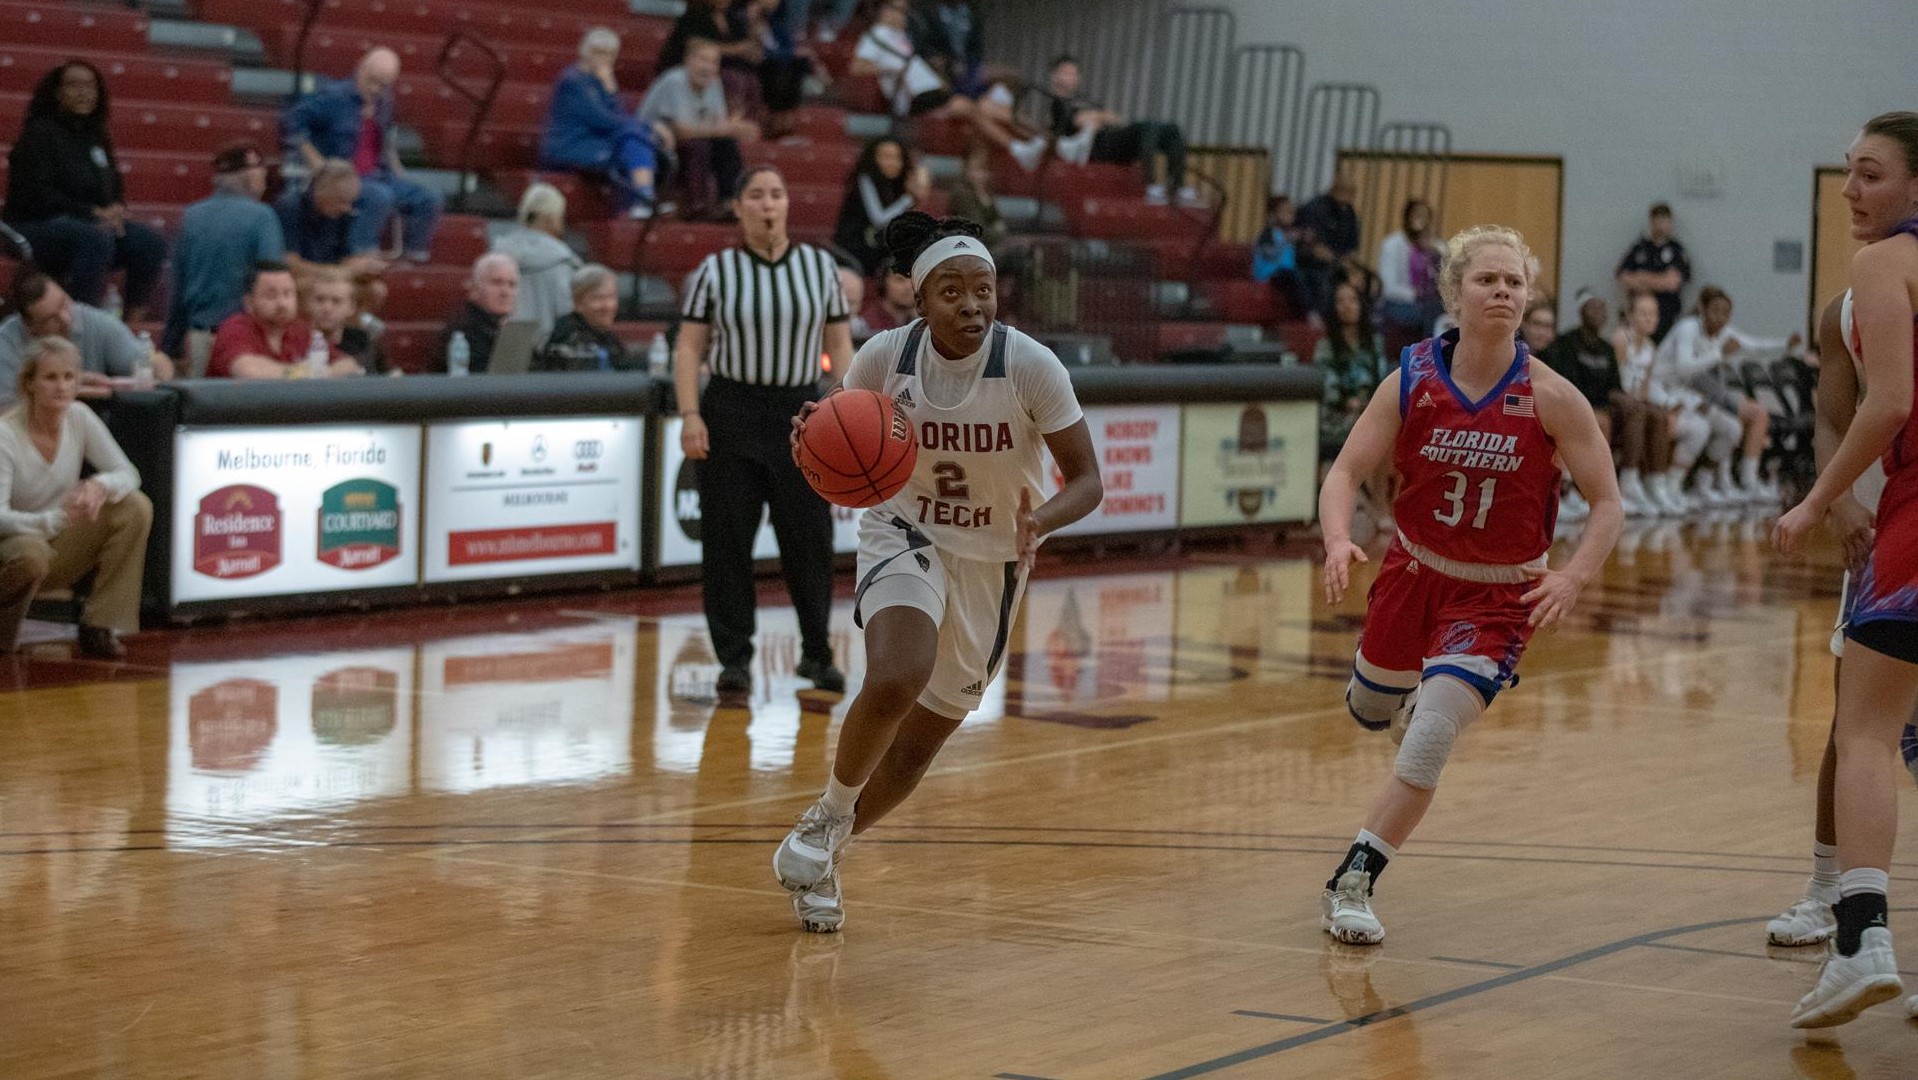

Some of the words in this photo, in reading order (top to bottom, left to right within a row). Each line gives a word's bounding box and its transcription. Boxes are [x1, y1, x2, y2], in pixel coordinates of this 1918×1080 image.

[916, 421, 1014, 452] ORIDA
[1430, 428, 1518, 454] FLORIDA
[217, 447, 318, 470] Melbourne,
[326, 442, 386, 465] Florida
[1420, 445, 1524, 472] SOUTHERN
[932, 460, 970, 500] 2
[917, 495, 993, 528] TECH
[1432, 471, 1497, 530] 31
[203, 513, 275, 536] Residence
